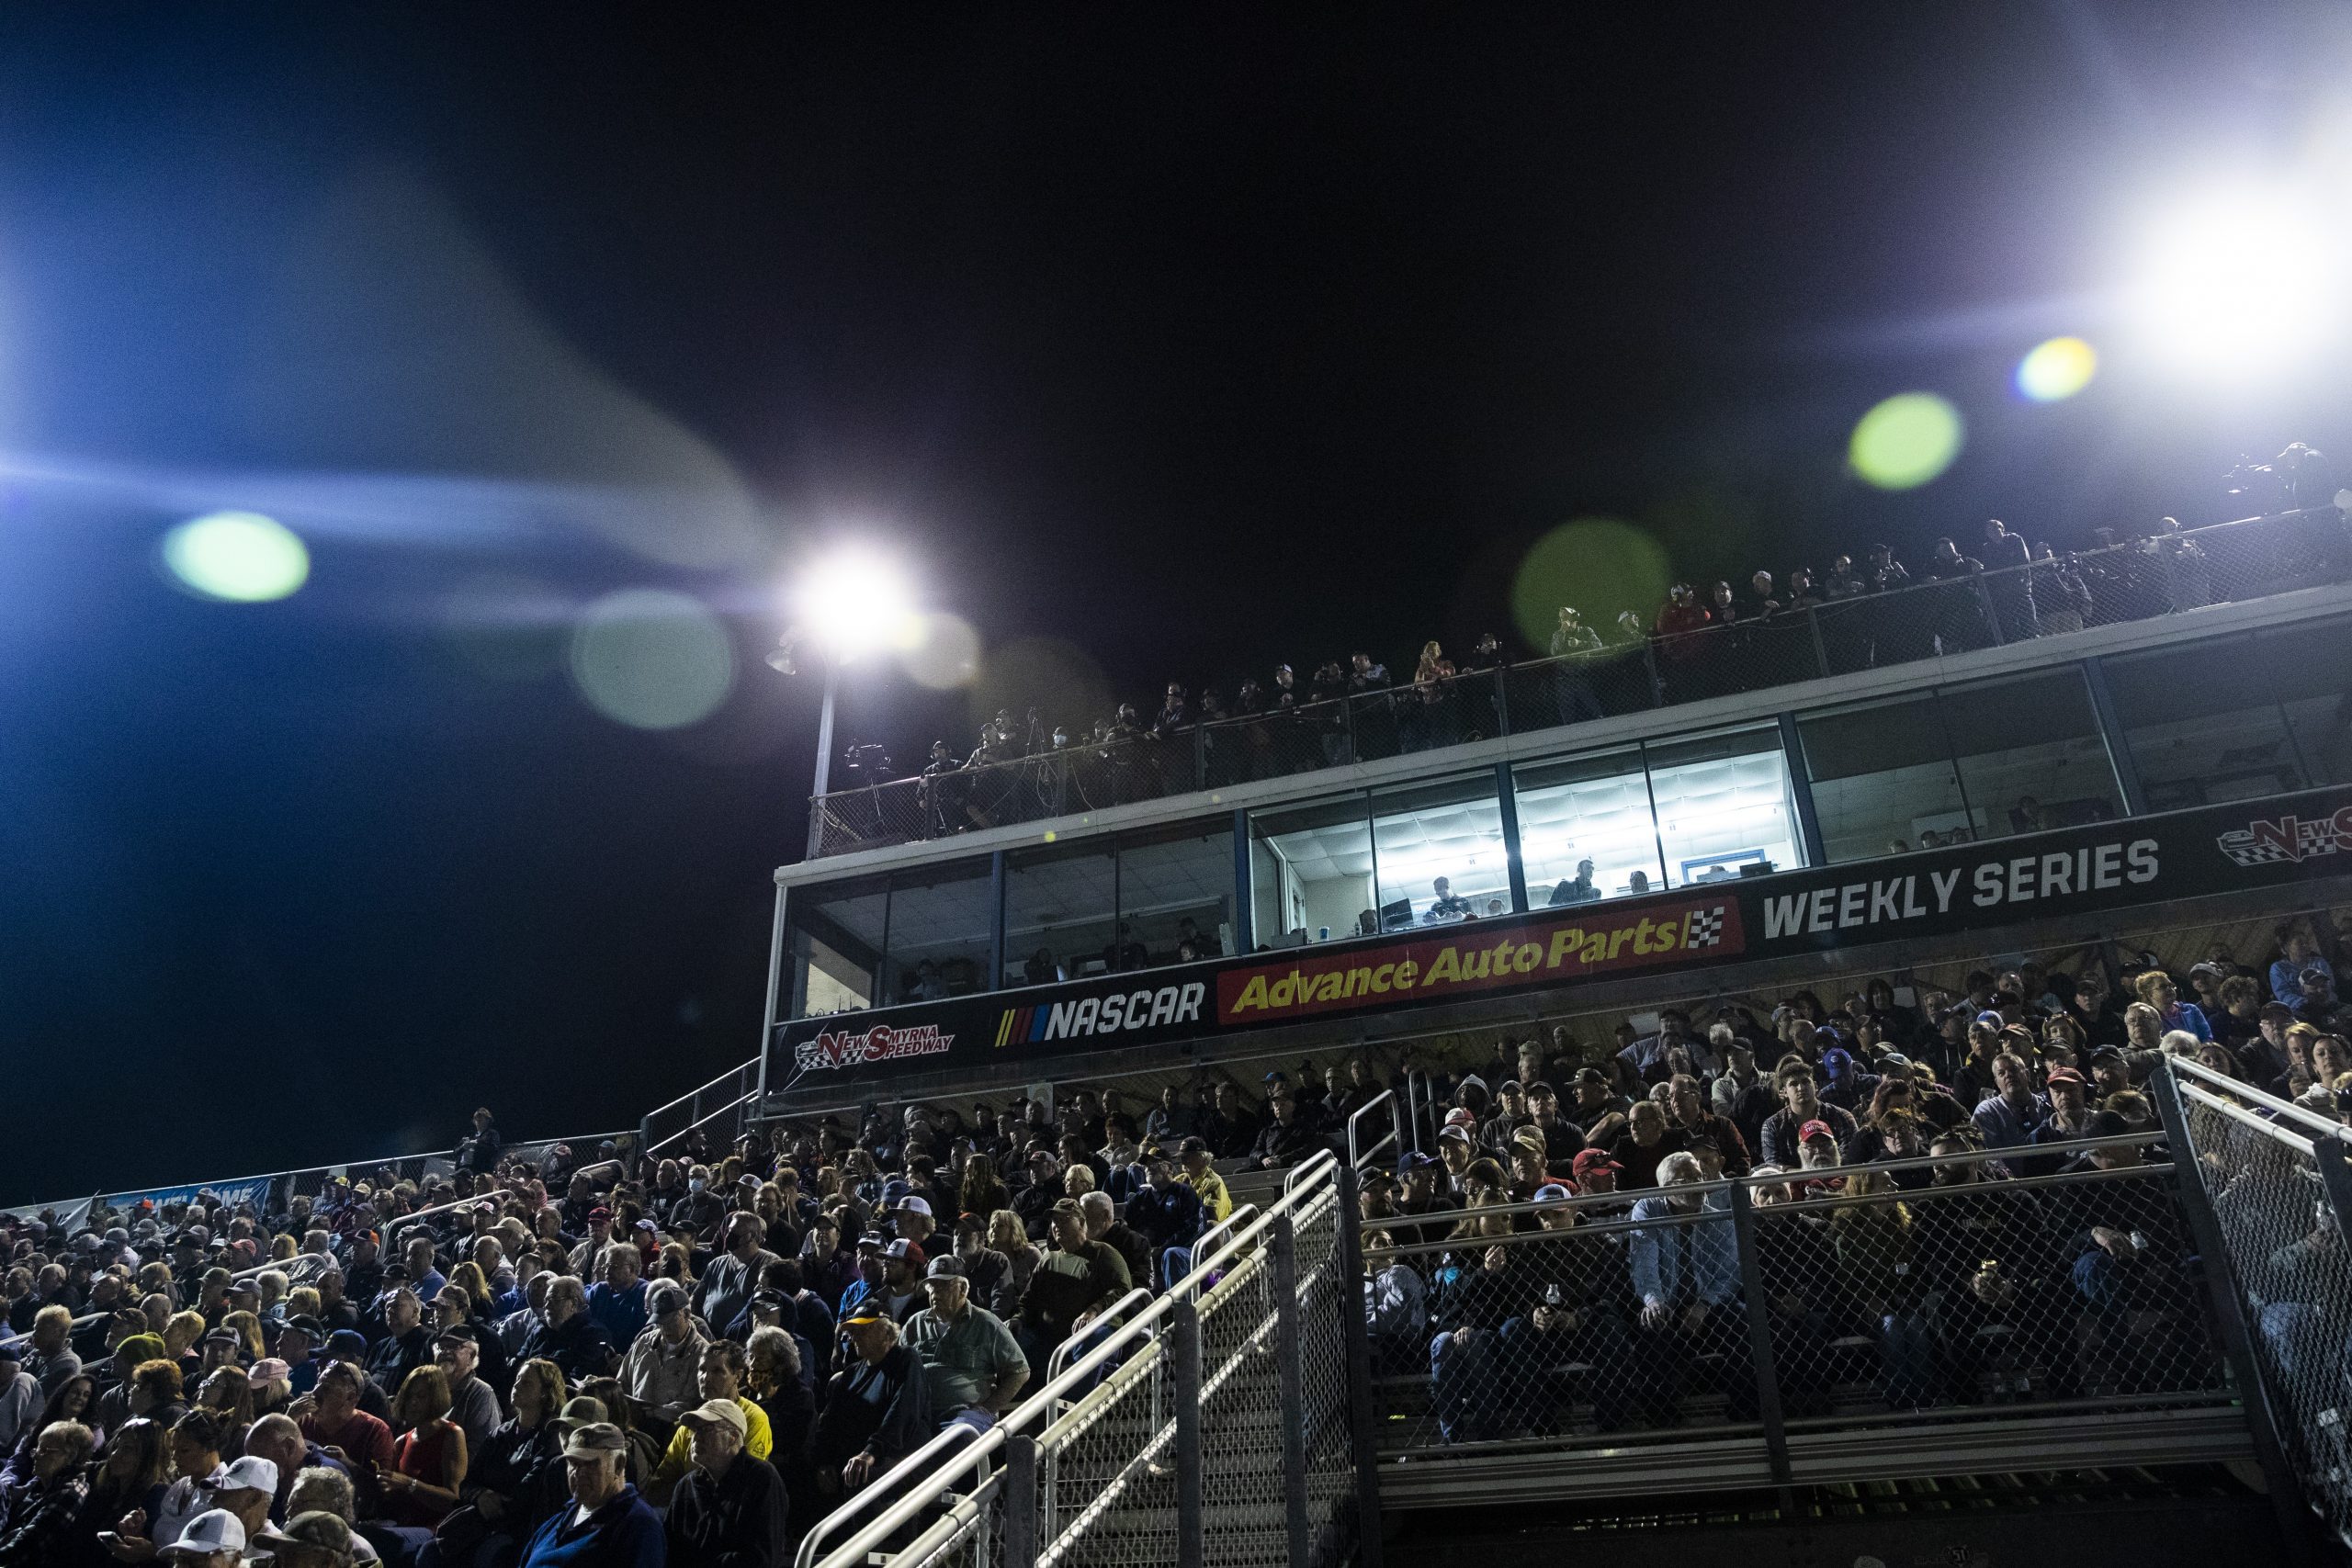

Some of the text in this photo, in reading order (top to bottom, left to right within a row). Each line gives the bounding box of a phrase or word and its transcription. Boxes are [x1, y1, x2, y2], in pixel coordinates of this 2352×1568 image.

[1763, 838, 2160, 940] WEEKLY SERIES
[1232, 917, 1678, 1013] Advance Auto Parts
[865, 1024, 939, 1061] SMYRNA
[1044, 982, 1205, 1041] NASCAR
